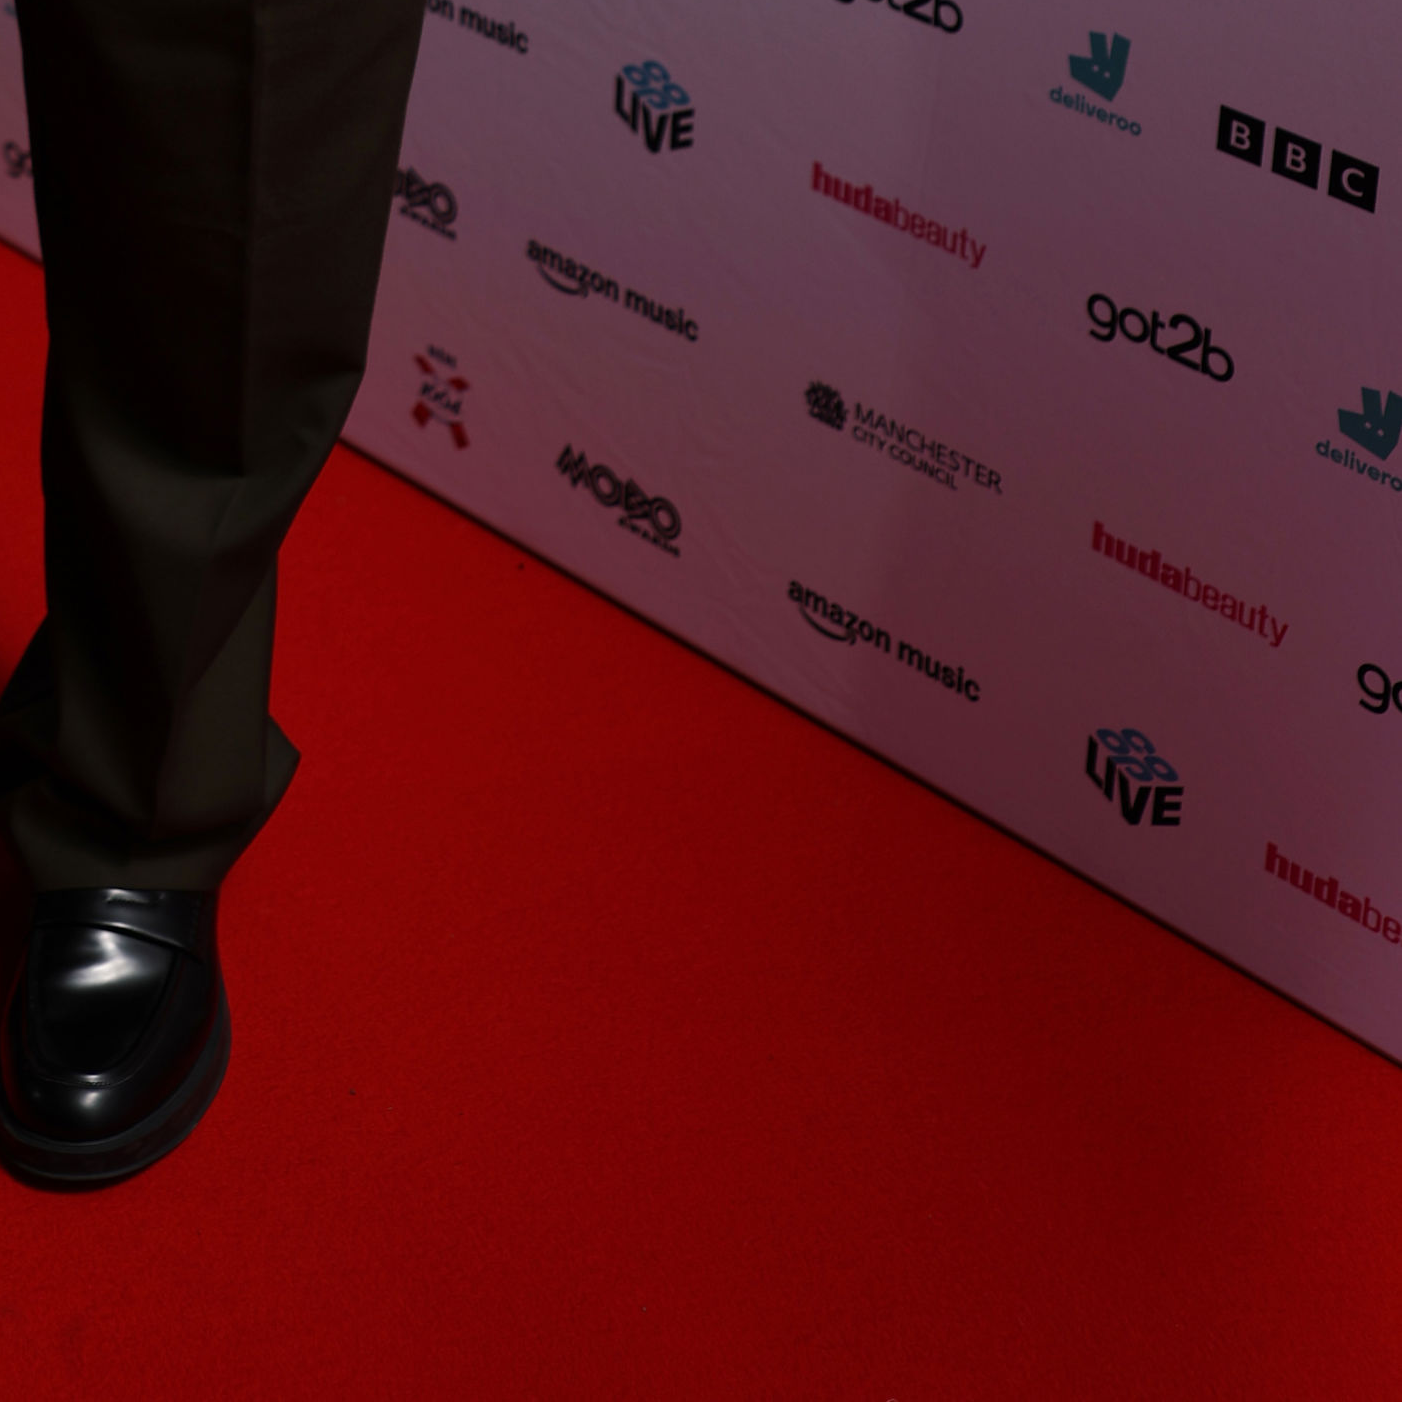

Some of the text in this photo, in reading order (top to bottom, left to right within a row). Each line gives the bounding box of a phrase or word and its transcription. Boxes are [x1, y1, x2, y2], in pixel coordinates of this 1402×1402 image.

[456, 2, 530, 56] music
[611, 70, 698, 156] LIVE
[1047, 83, 1143, 138] deliveroo
[1220, 109, 1378, 209] BBC
[810, 159, 989, 272] hudabeauty
[624, 287, 701, 345] music
[1085, 291, 1238, 384] got2b
[850, 424, 959, 492] CITY COUNCIL
[853, 401, 1004, 496] MANCHESTER
[1090, 519, 1290, 650] hudabeauty
[788, 580, 982, 704] amazon music
[1084, 733, 1187, 831] LIVE
